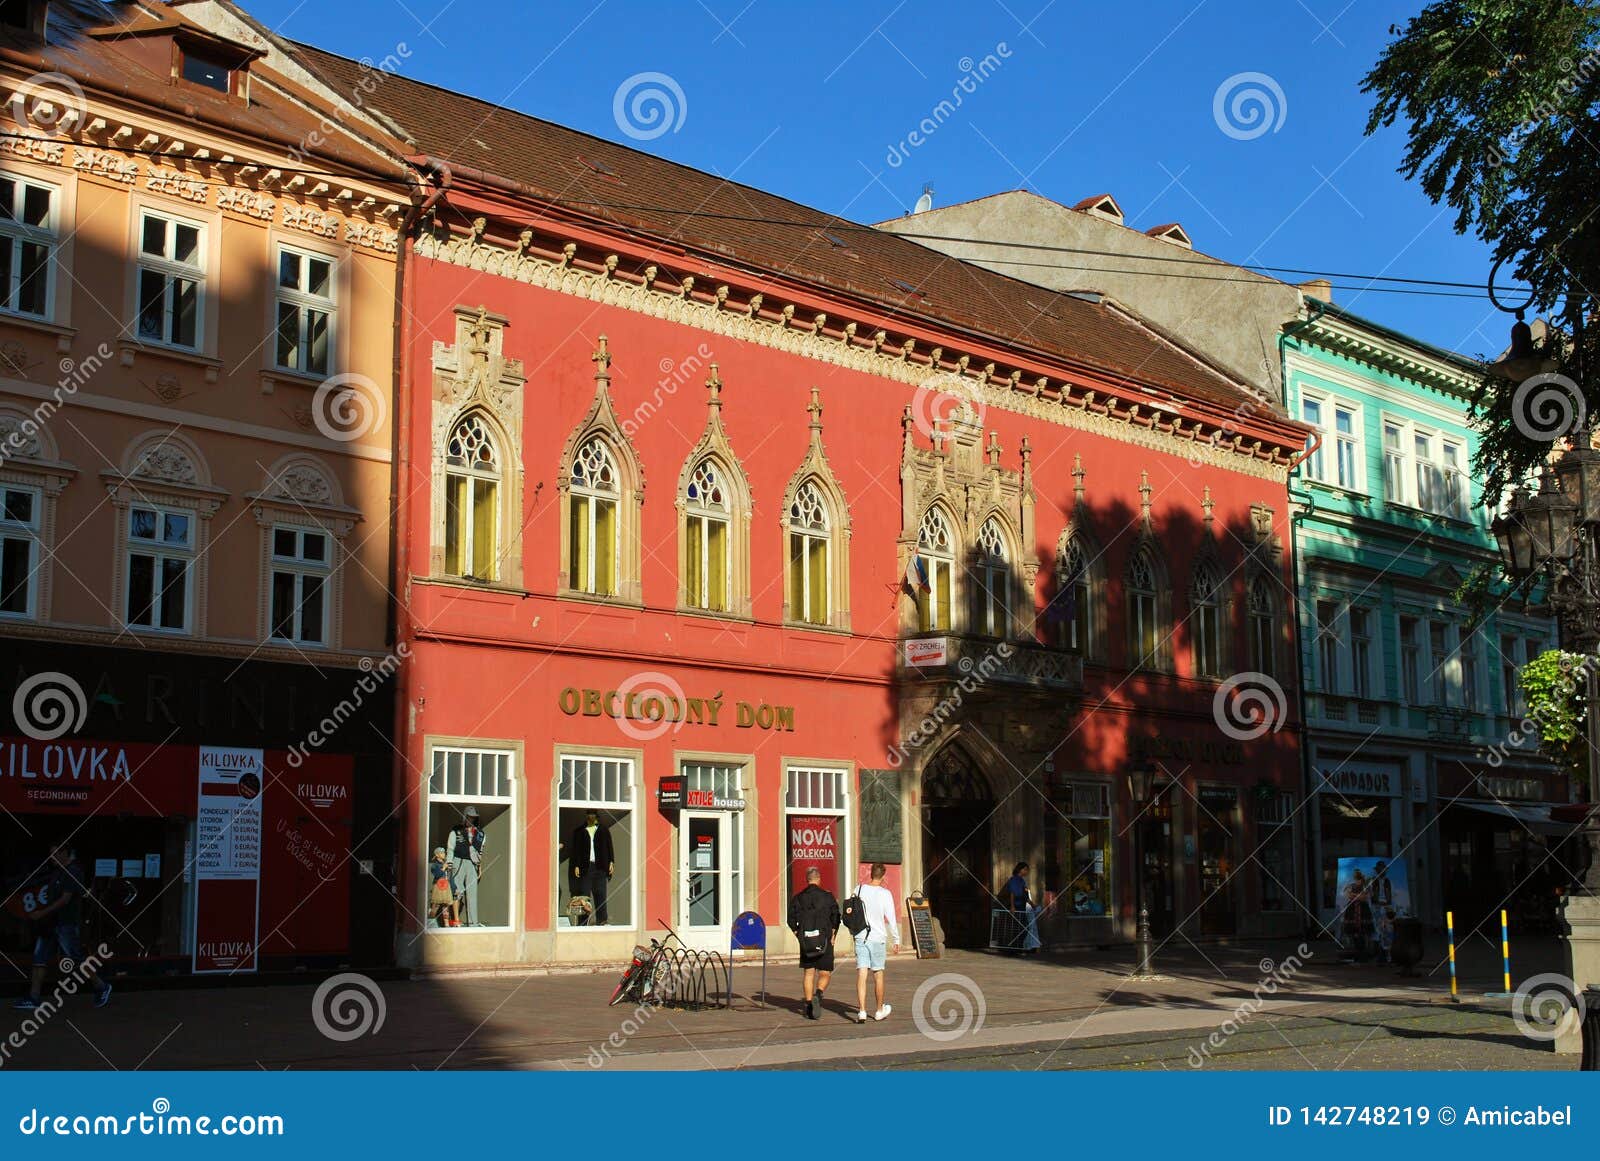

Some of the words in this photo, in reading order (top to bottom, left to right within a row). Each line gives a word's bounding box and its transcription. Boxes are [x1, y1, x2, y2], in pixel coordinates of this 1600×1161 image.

[558, 687, 723, 726] OBCHODNÝ
[736, 702, 795, 732] DOM
[0, 742, 132, 782] ILOVKA
[202, 752, 256, 768] KILOVKA
[27, 790, 89, 801] SECONDHAND
[298, 783, 347, 799] KILOVKA
[687, 790, 714, 807] XTILE
[714, 796, 746, 808] house
[792, 825, 834, 846] NOVÁ
[792, 848, 834, 858] KOLEKCIA
[199, 941, 253, 957] KILOVKA
